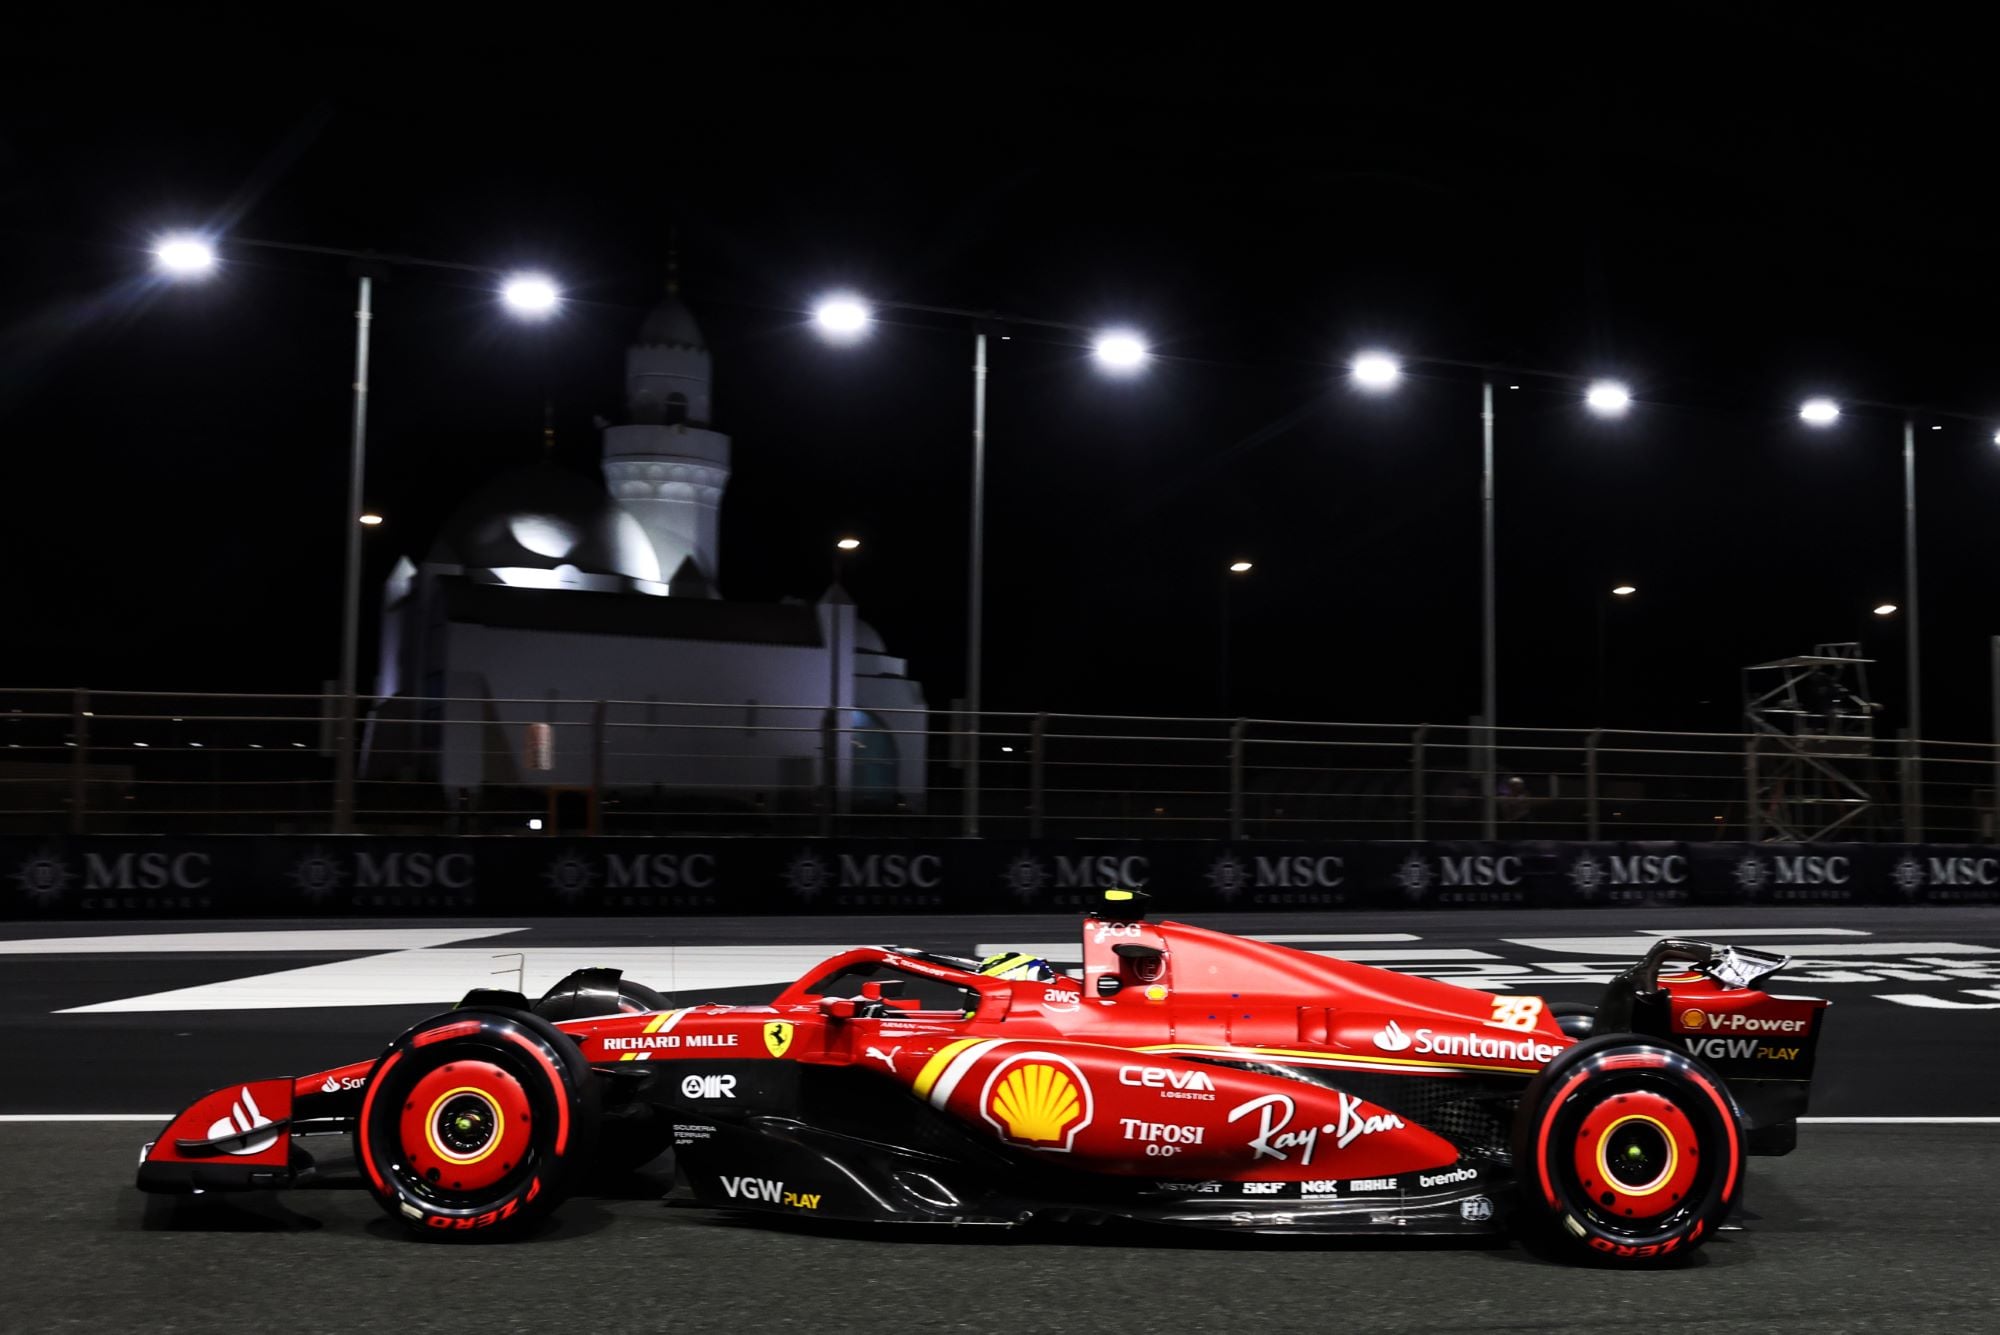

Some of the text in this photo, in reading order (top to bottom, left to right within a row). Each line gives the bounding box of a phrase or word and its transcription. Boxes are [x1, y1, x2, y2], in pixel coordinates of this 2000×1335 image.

[81, 852, 212, 889] MSC
[352, 852, 474, 888] MSC
[602, 853, 715, 888] MSC
[838, 854, 942, 888] MSC
[1052, 855, 1150, 887] MSC
[1253, 856, 1344, 887] MSC
[1439, 856, 1521, 886] MSC
[1608, 855, 1688, 884] MSC
[1774, 856, 1850, 884] MSC
[1926, 857, 1999, 885] MSC
[1044, 988, 1080, 1004] aws
[1484, 996, 1542, 1032] 38
[1707, 1013, 1806, 1032] V-Power
[603, 1034, 739, 1050] RICHARD MILLE
[1684, 1038, 1800, 1061] VGW PLAY
[1160, 1091, 1216, 1101] LOGISTICS
[672, 1124, 717, 1132] SCUDERIA
[1119, 1118, 1205, 1144] TIFOSI
[719, 1175, 821, 1209] VGW PLAY
[1242, 1182, 1287, 1194] SKF
[1301, 1180, 1338, 1194] NGK
[1350, 1178, 1397, 1192] MAHLE
[1419, 1168, 1478, 1188] brembo
